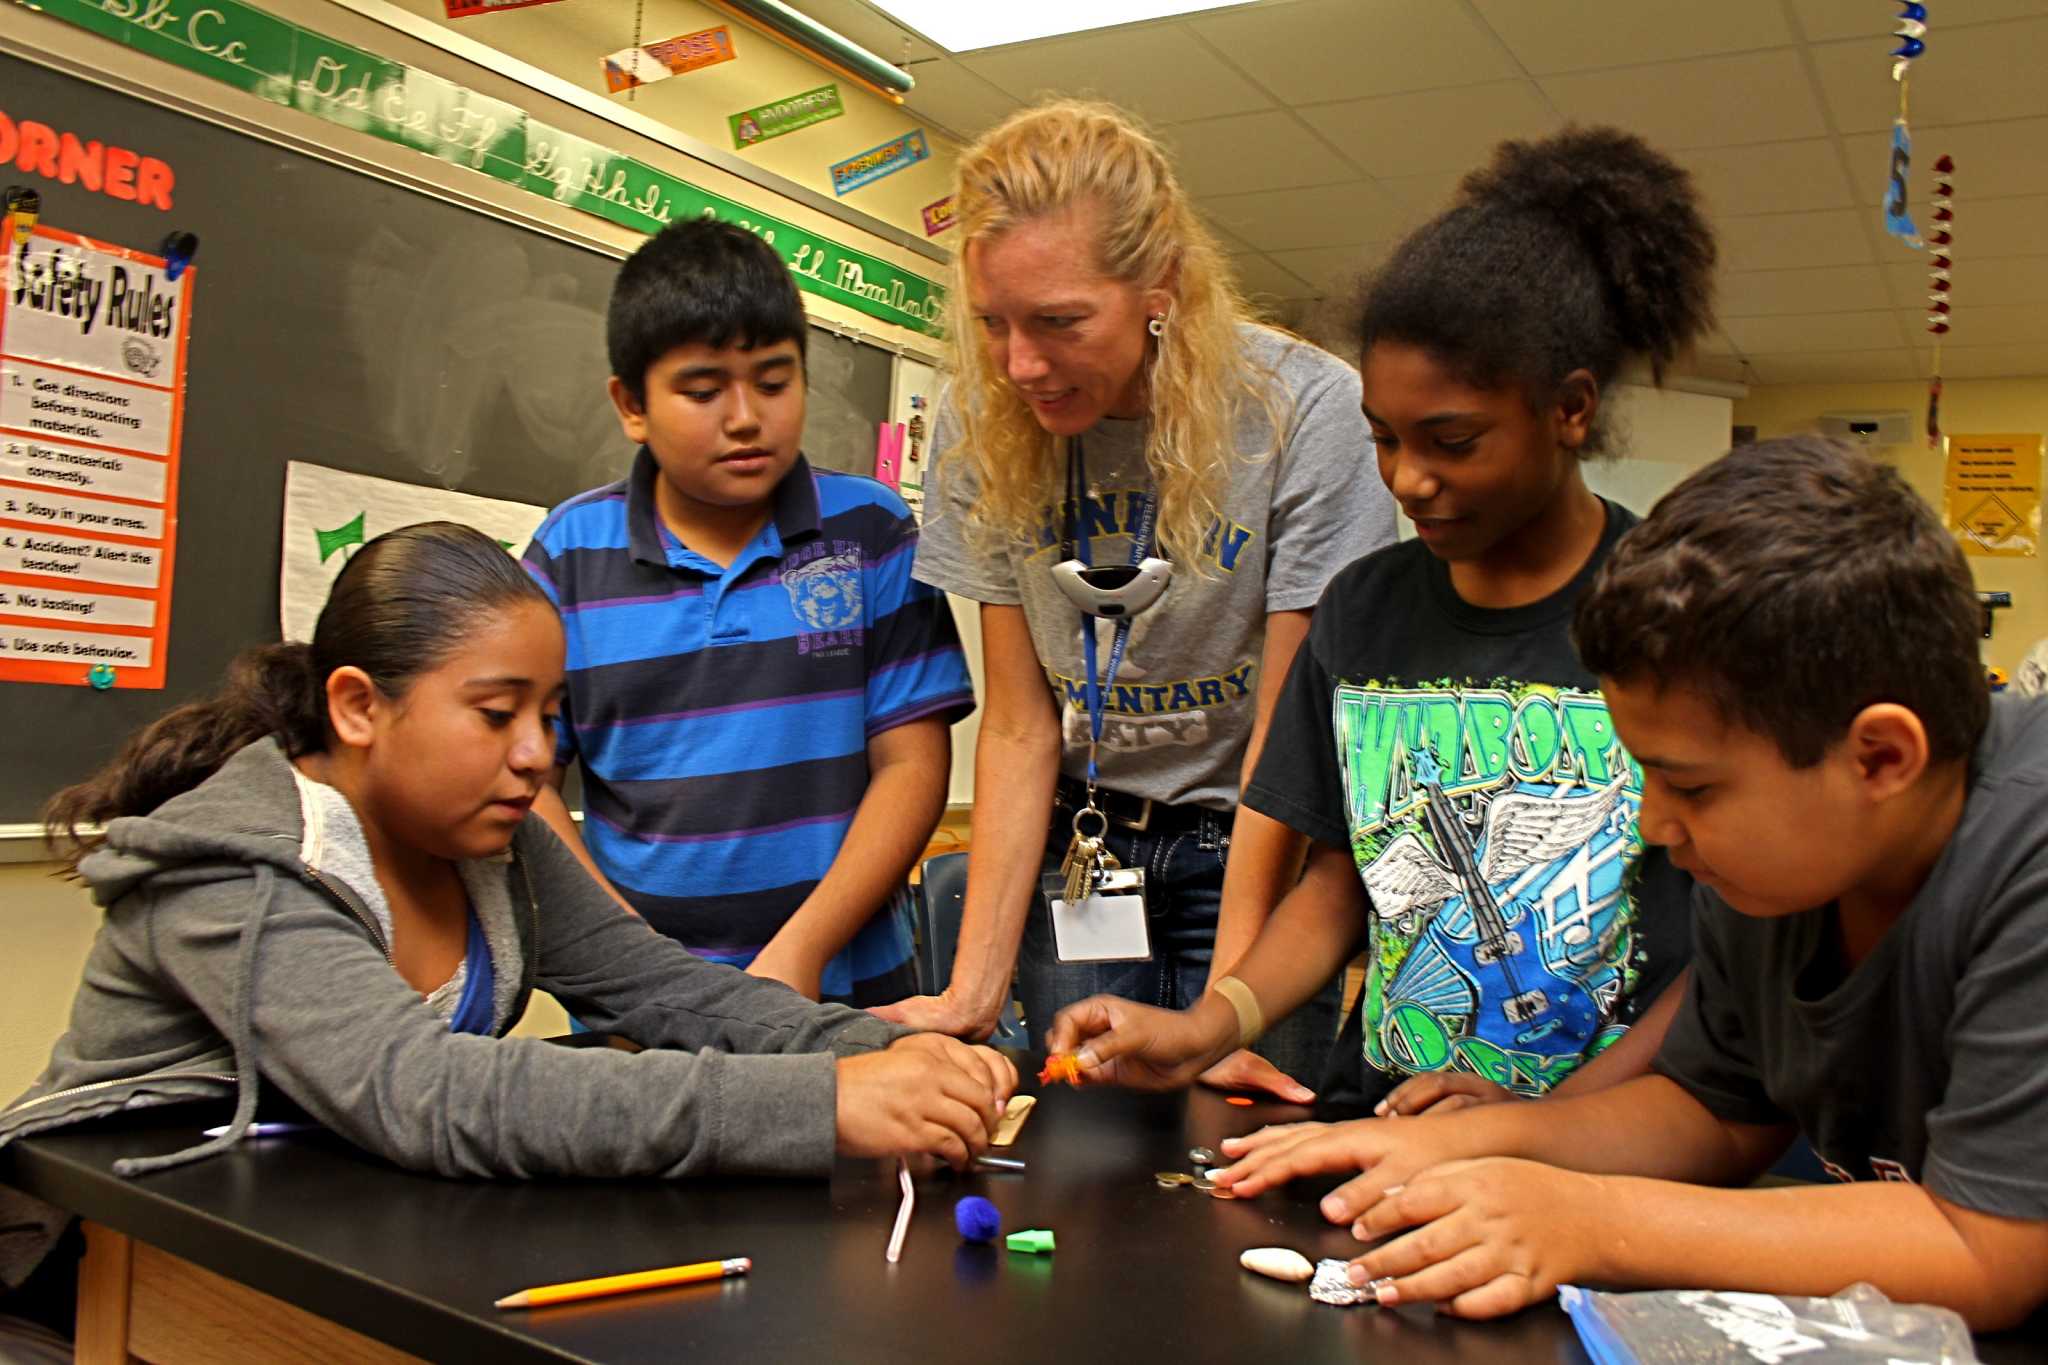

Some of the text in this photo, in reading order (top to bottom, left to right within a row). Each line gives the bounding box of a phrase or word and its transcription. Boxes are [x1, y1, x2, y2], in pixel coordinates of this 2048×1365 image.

[105, 265, 175, 339] Rules
[32, 378, 59, 393] Get
[61, 384, 130, 407] directions
[81, 406, 141, 429] touching
[27, 445, 53, 460] Use
[56, 451, 122, 471] materials
[26, 501, 57, 519] Stay
[60, 507, 74, 519] in
[77, 512, 110, 524] your
[111, 516, 147, 530] area.
[23, 537, 91, 557] Accident?
[94, 547, 128, 562] Alert
[129, 551, 152, 565] the
[21, 557, 81, 574] teacher!
[16, 594, 37, 608] No
[14, 638, 39, 652] Use
[41, 641, 70, 655] safe
[72, 643, 138, 660] behavior.
[1056, 664, 1256, 714] MNTARY
